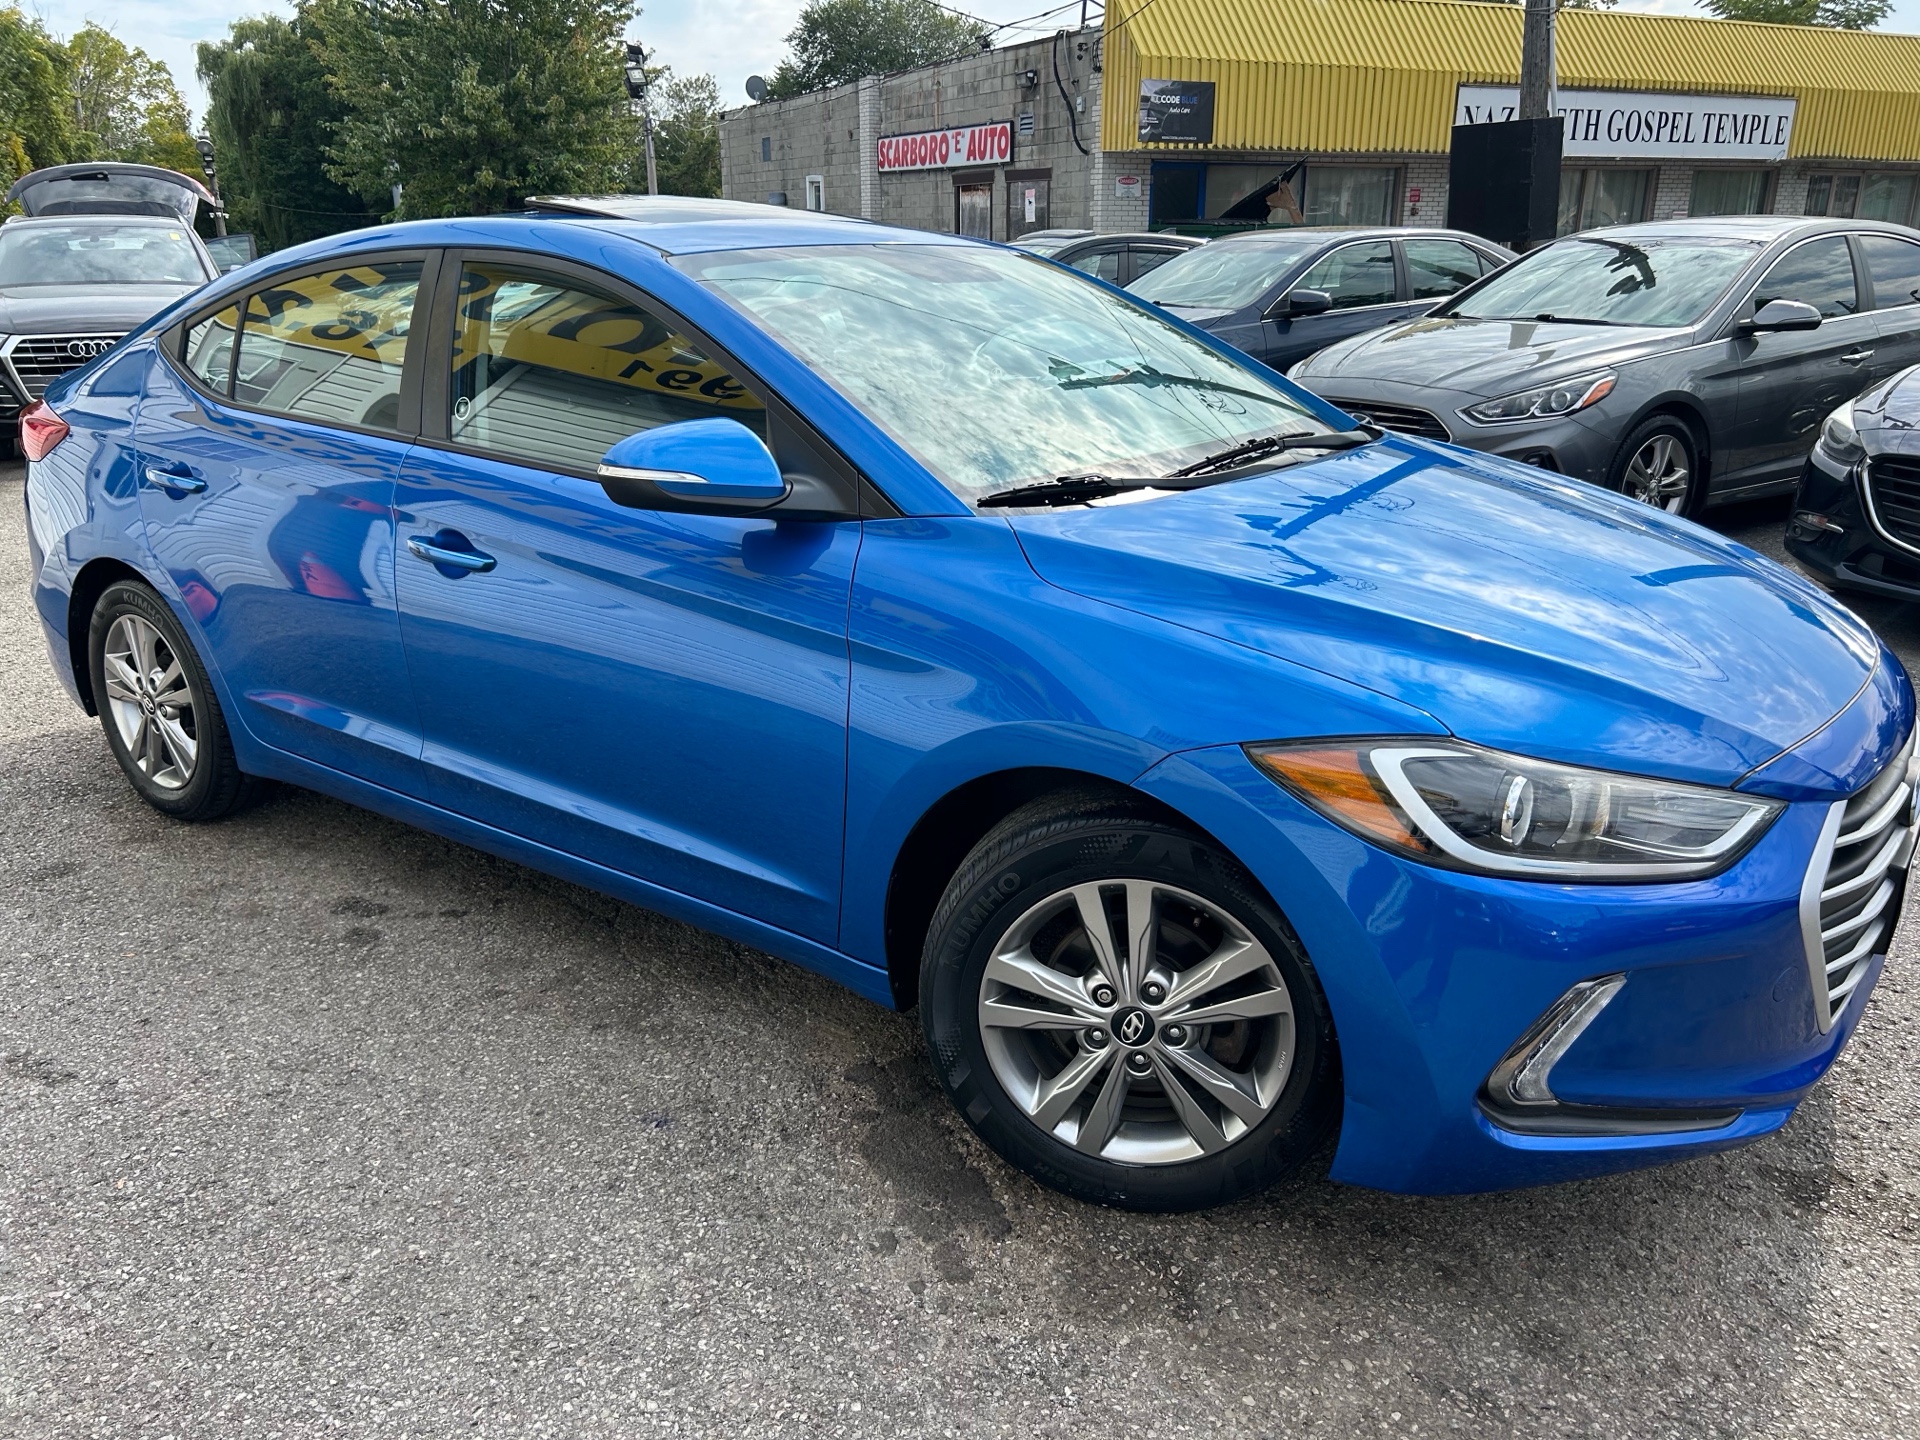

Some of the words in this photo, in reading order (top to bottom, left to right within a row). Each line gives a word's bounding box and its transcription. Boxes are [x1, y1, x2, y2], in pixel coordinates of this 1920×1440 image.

[1160, 95, 1180, 104] CODE
[1181, 96, 1198, 104] BLUE
[1606, 109, 1697, 143] GOSPEL
[1701, 112, 1789, 145] TEMPLE
[878, 132, 950, 169] SCARBORO
[966, 125, 1009, 161] AUTO
[123, 591, 164, 628] KUMHO
[942, 872, 1021, 969] KUMHO
